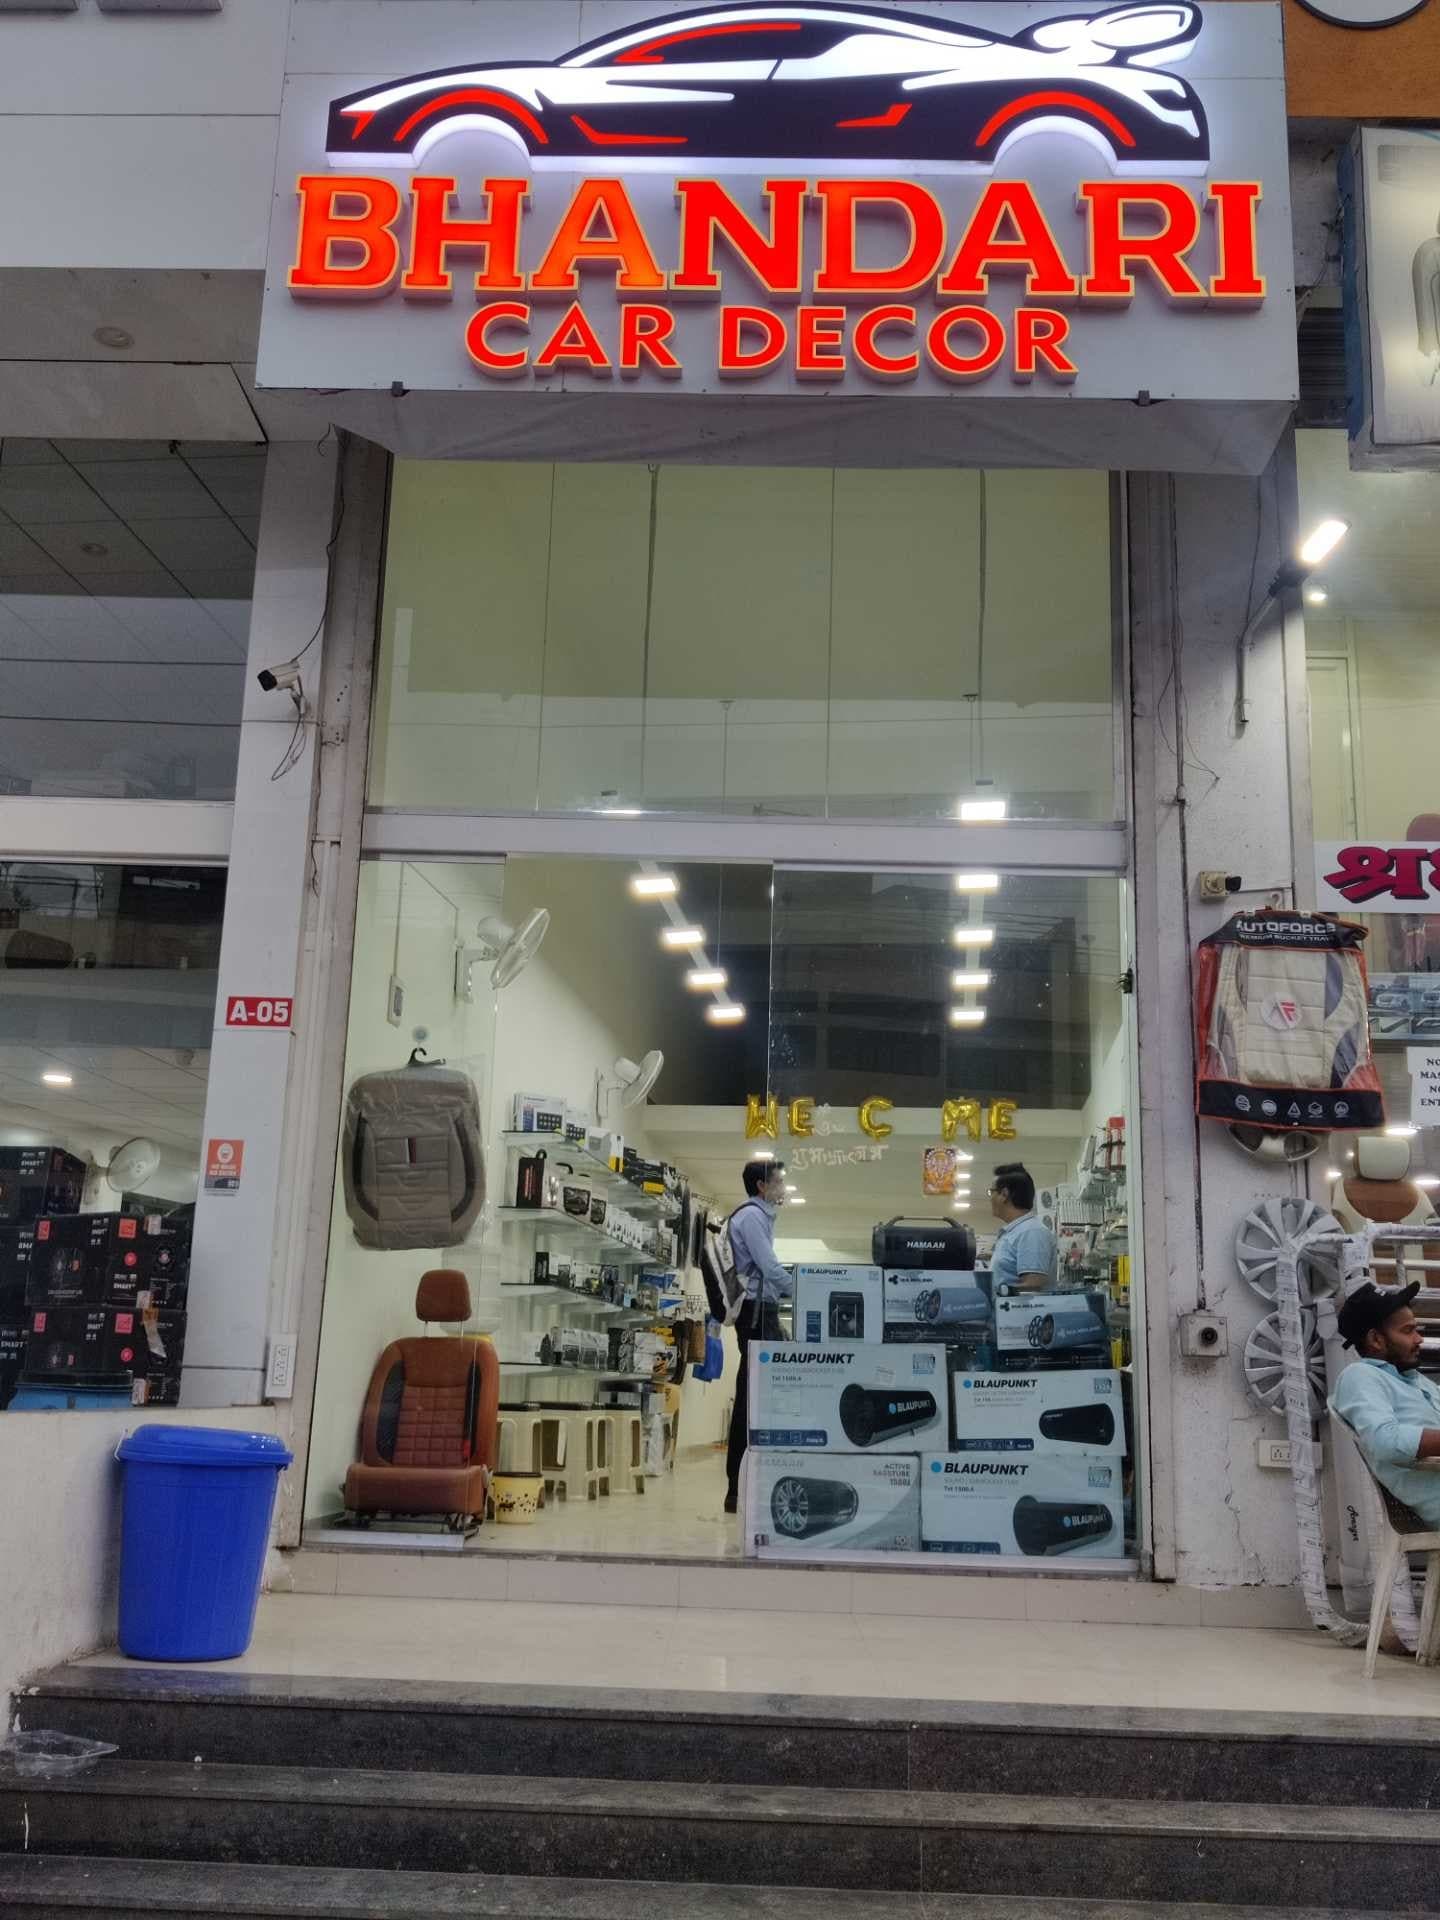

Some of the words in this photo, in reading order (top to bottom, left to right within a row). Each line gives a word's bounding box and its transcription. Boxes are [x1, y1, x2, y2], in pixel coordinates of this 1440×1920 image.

[290, 174, 1263, 299] BHANDARI
[465, 302, 681, 379] CAR
[718, 304, 1079, 385] DECOR
[229, 1000, 289, 1024] A-05
[906, 1240, 946, 1249] HAMAAN
[771, 1352, 855, 1364] BLAUPUNKT
[973, 1379, 1038, 1389] BLAUPUNKT
[897, 1400, 932, 1413] BLAUPUNKT
[944, 1462, 1029, 1475] BLAUPUNKT
